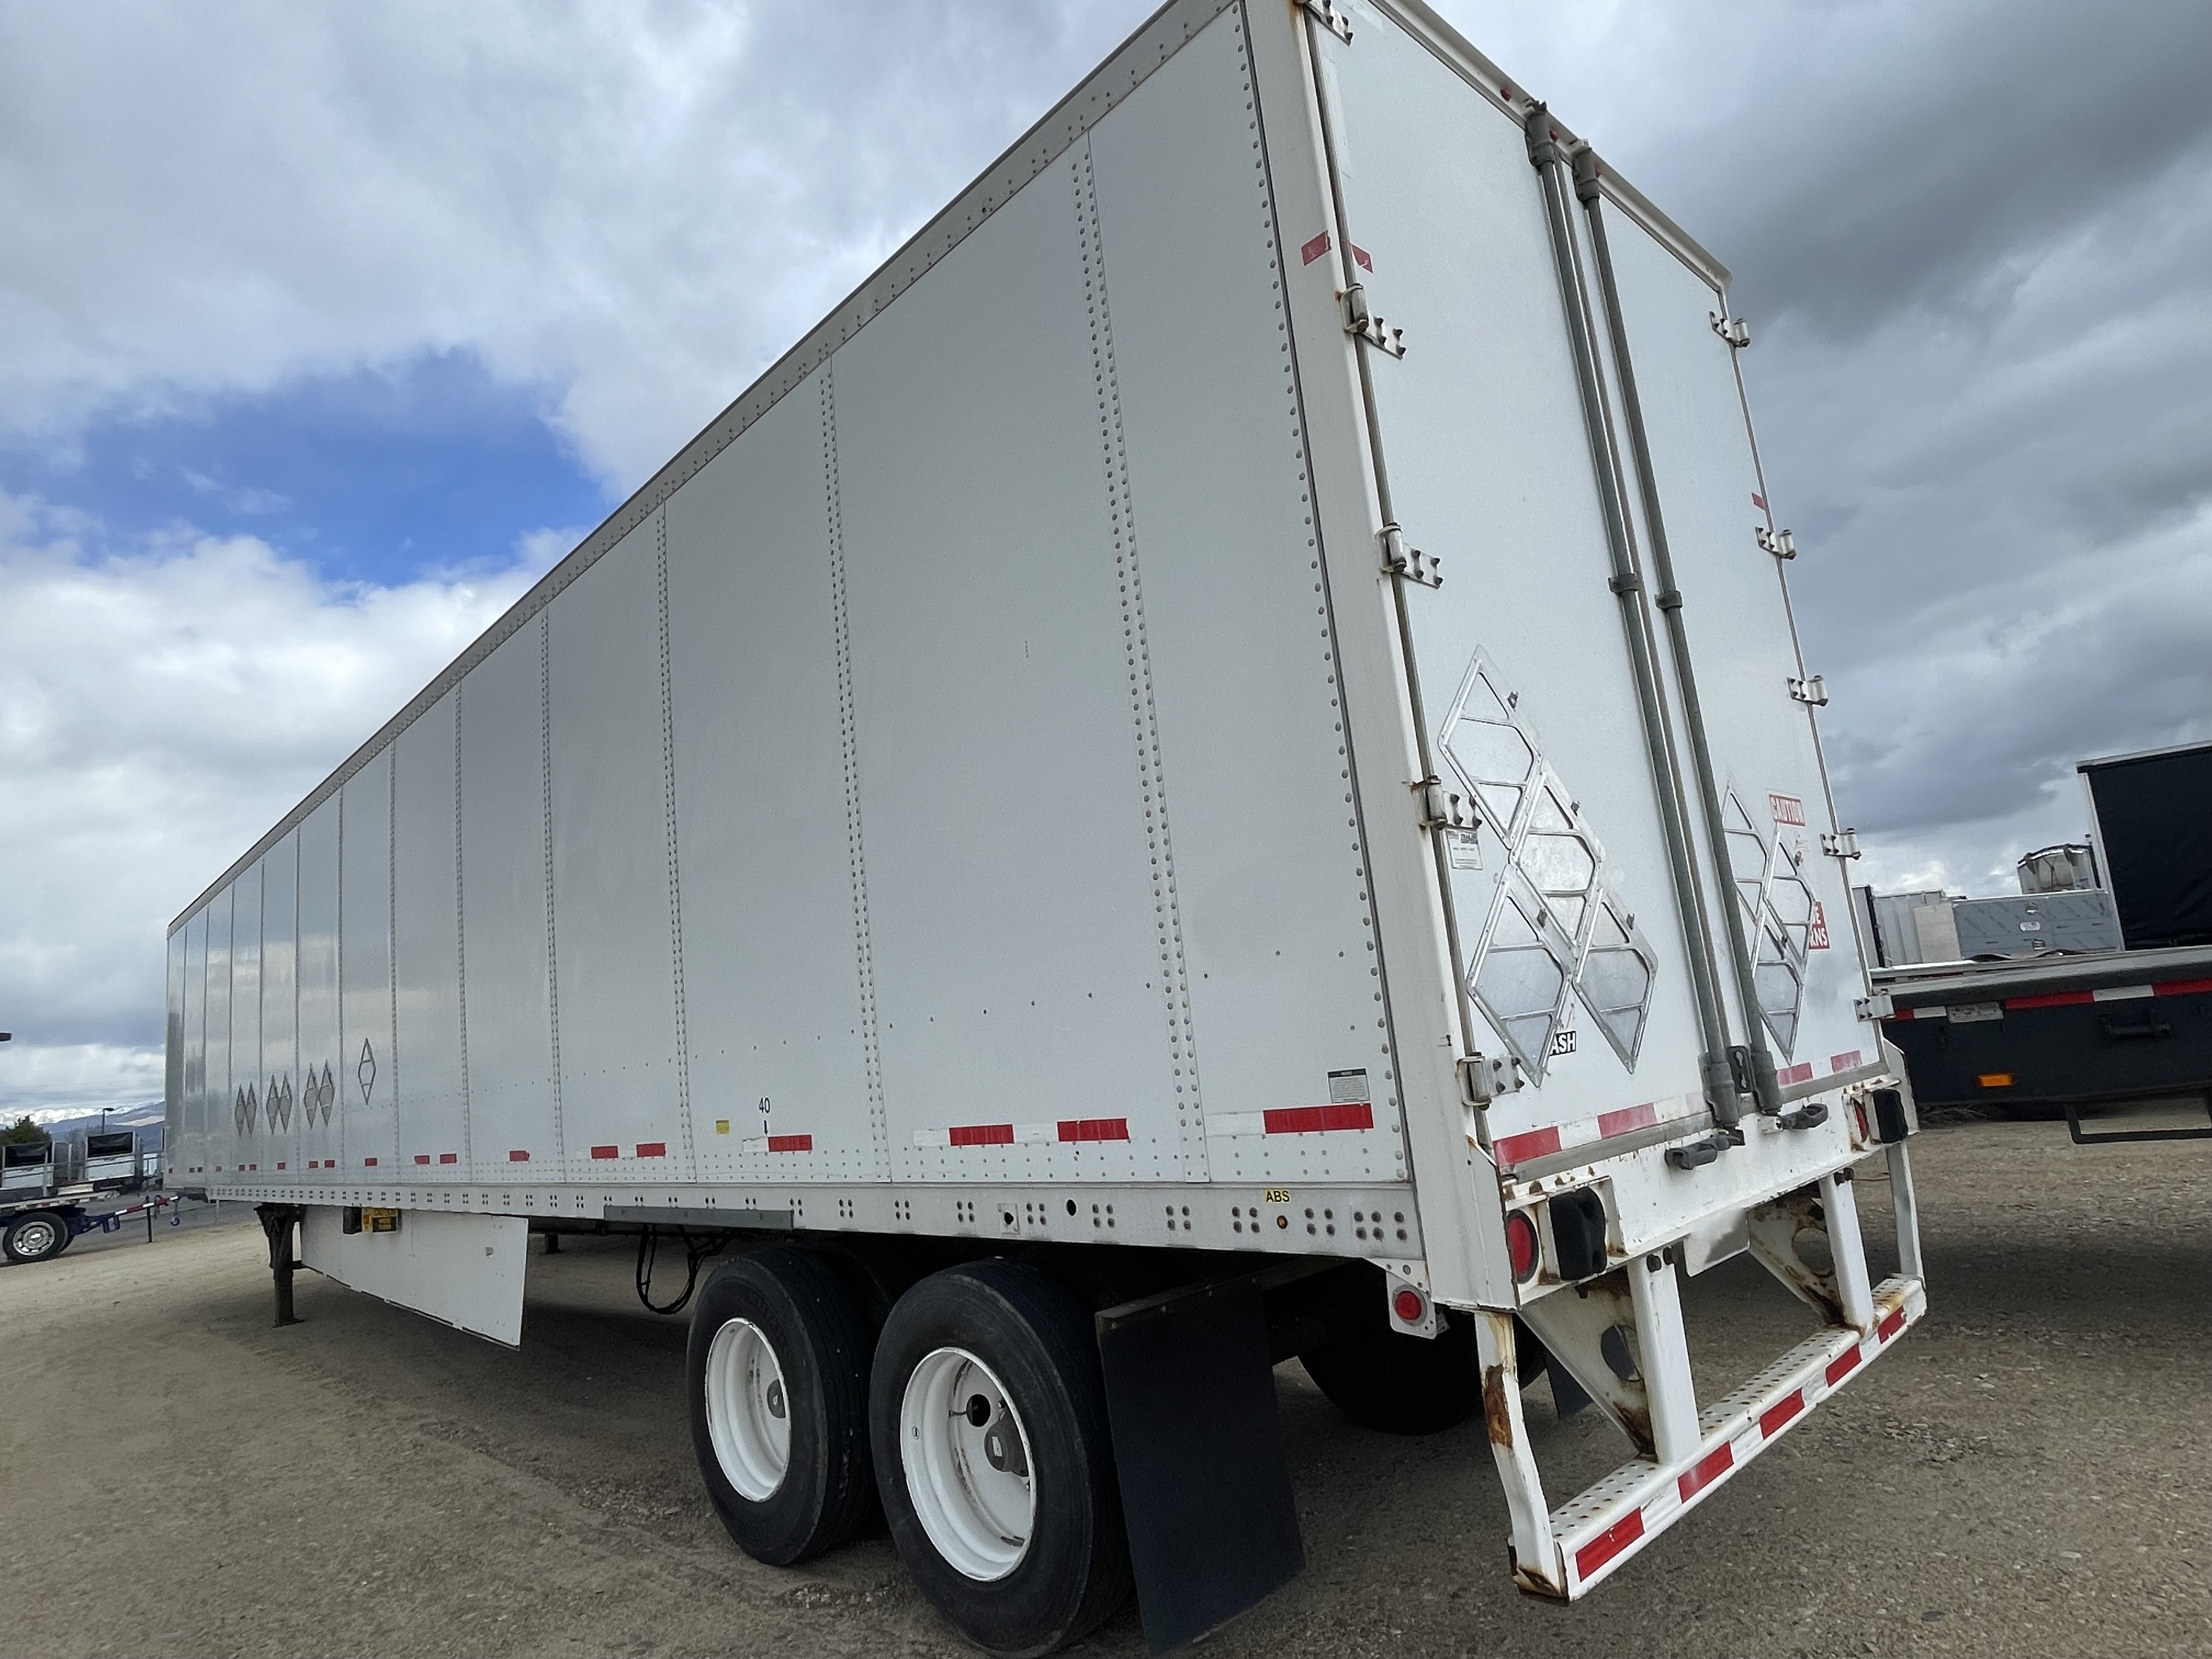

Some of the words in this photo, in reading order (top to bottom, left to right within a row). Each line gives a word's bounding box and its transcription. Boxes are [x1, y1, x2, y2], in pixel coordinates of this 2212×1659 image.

[1770, 797, 1805, 823] CAUTION
[758, 1097, 770, 1114] 40
[1266, 1190, 1290, 1203] ABS
